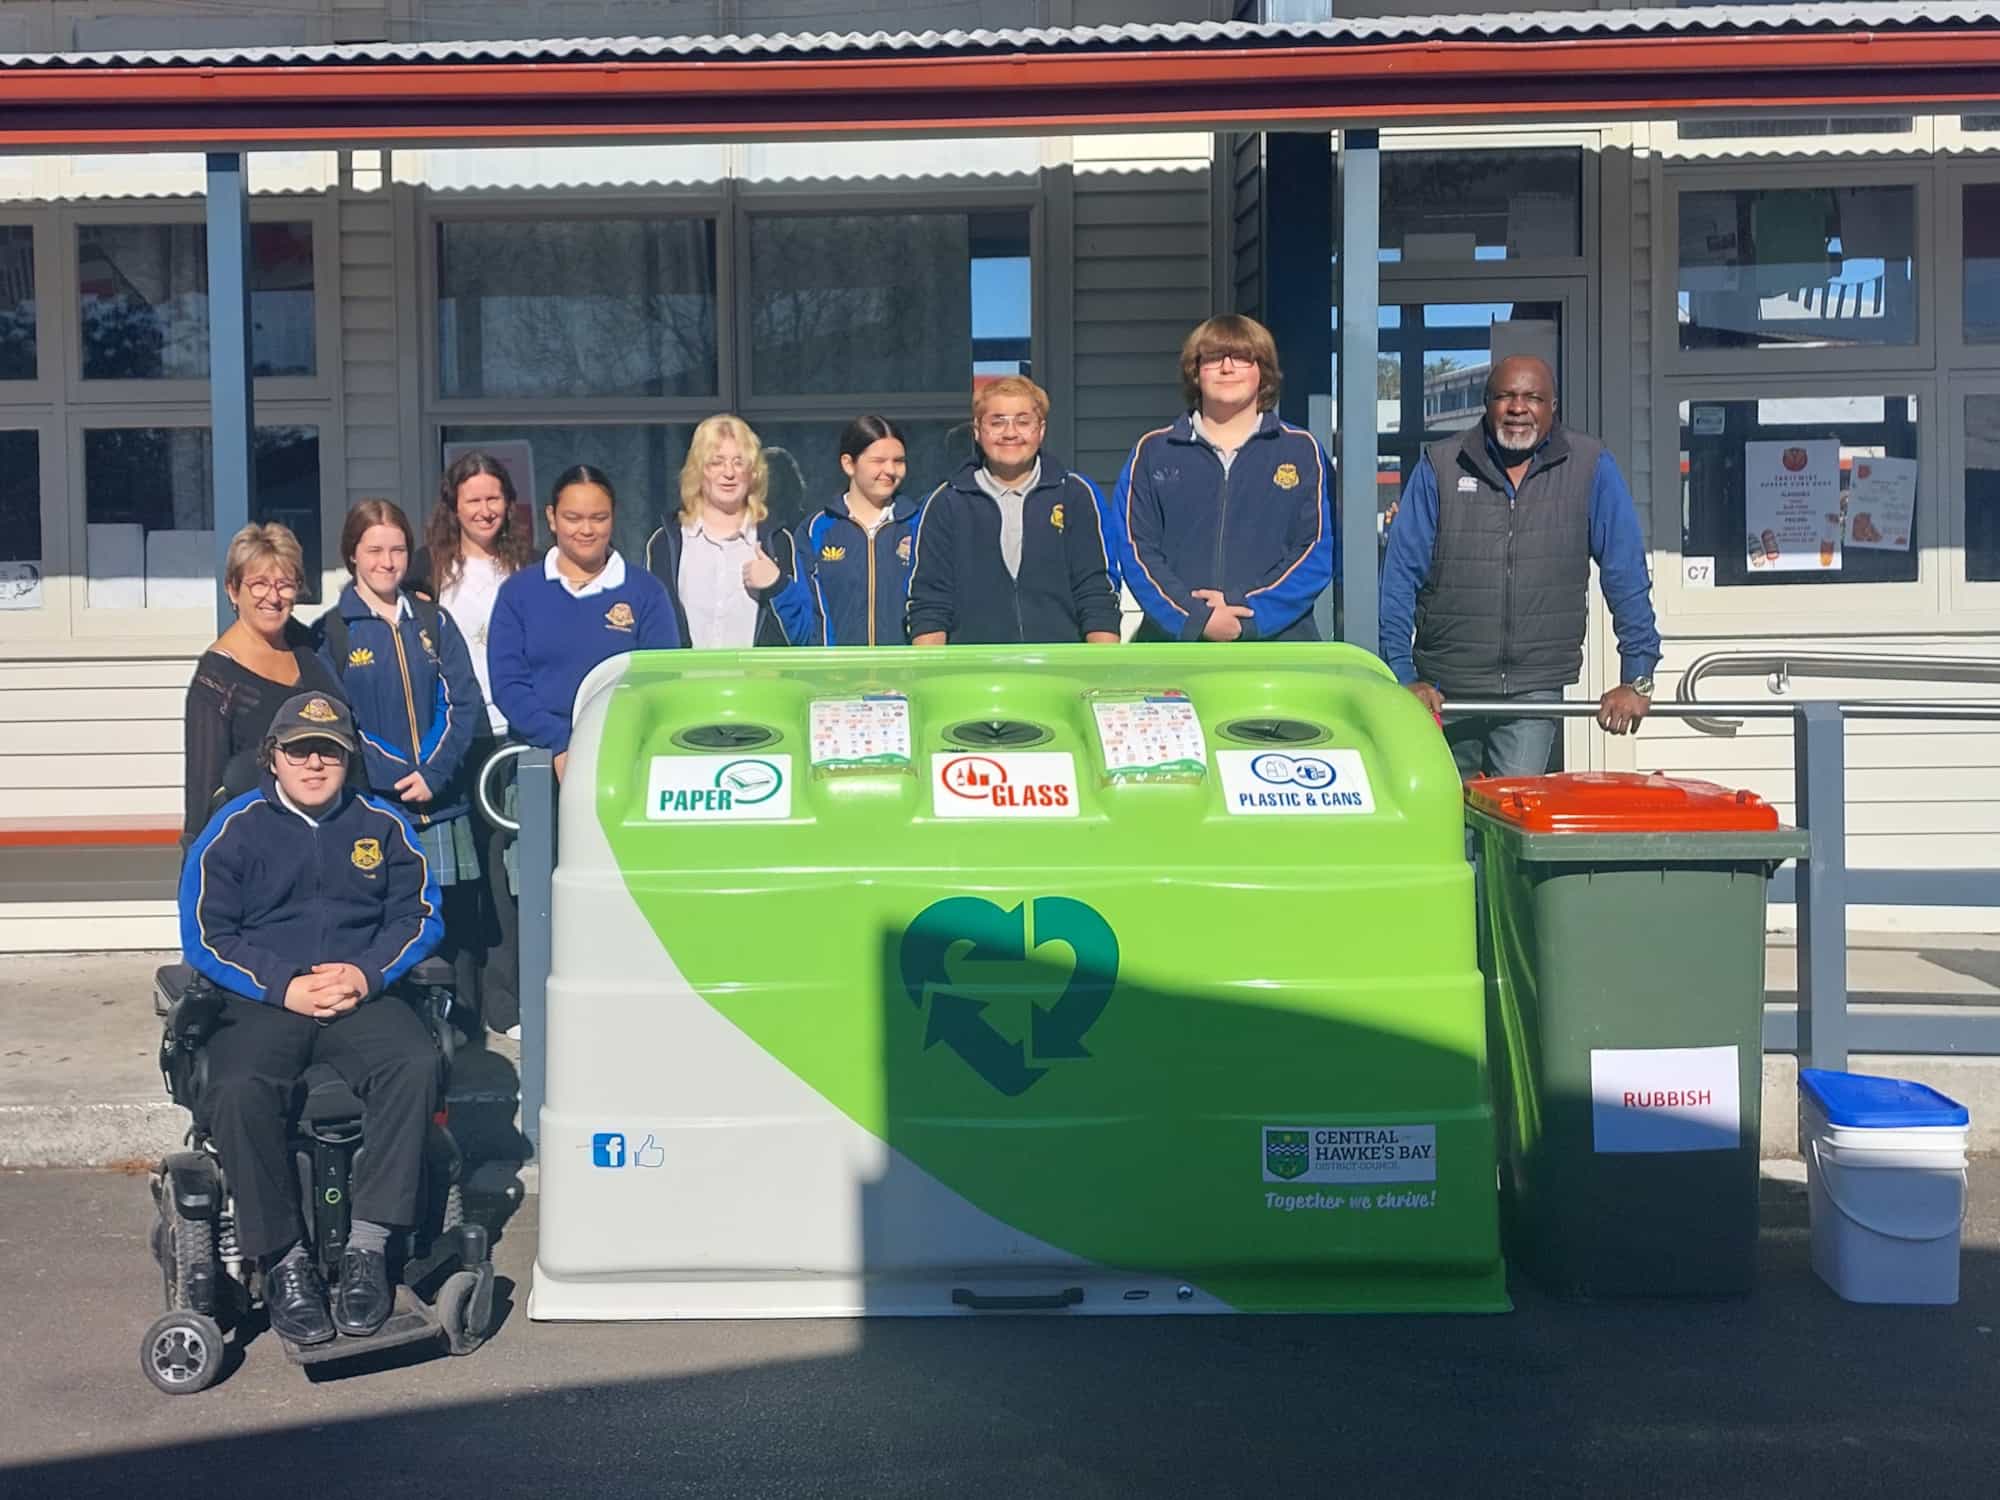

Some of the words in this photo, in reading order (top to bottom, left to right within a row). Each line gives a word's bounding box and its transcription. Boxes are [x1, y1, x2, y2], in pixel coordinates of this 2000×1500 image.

[1687, 565, 1709, 581] C7
[659, 788, 733, 812] PAPER
[991, 784, 1069, 807] GLASS
[1239, 792, 1301, 807] PLASTIC
[1305, 791, 1318, 807] &
[1321, 791, 1363, 807] CANS
[1623, 1089, 1712, 1108] RUBBISH
[1314, 1130, 1399, 1145] CENTRAL
[1315, 1145, 1395, 1161] HAWKE'S
[1399, 1144, 1433, 1160] BAY
[1264, 1192, 1344, 1212] Together
[1347, 1197, 1373, 1209] we
[1376, 1189, 1437, 1209] thrive!
